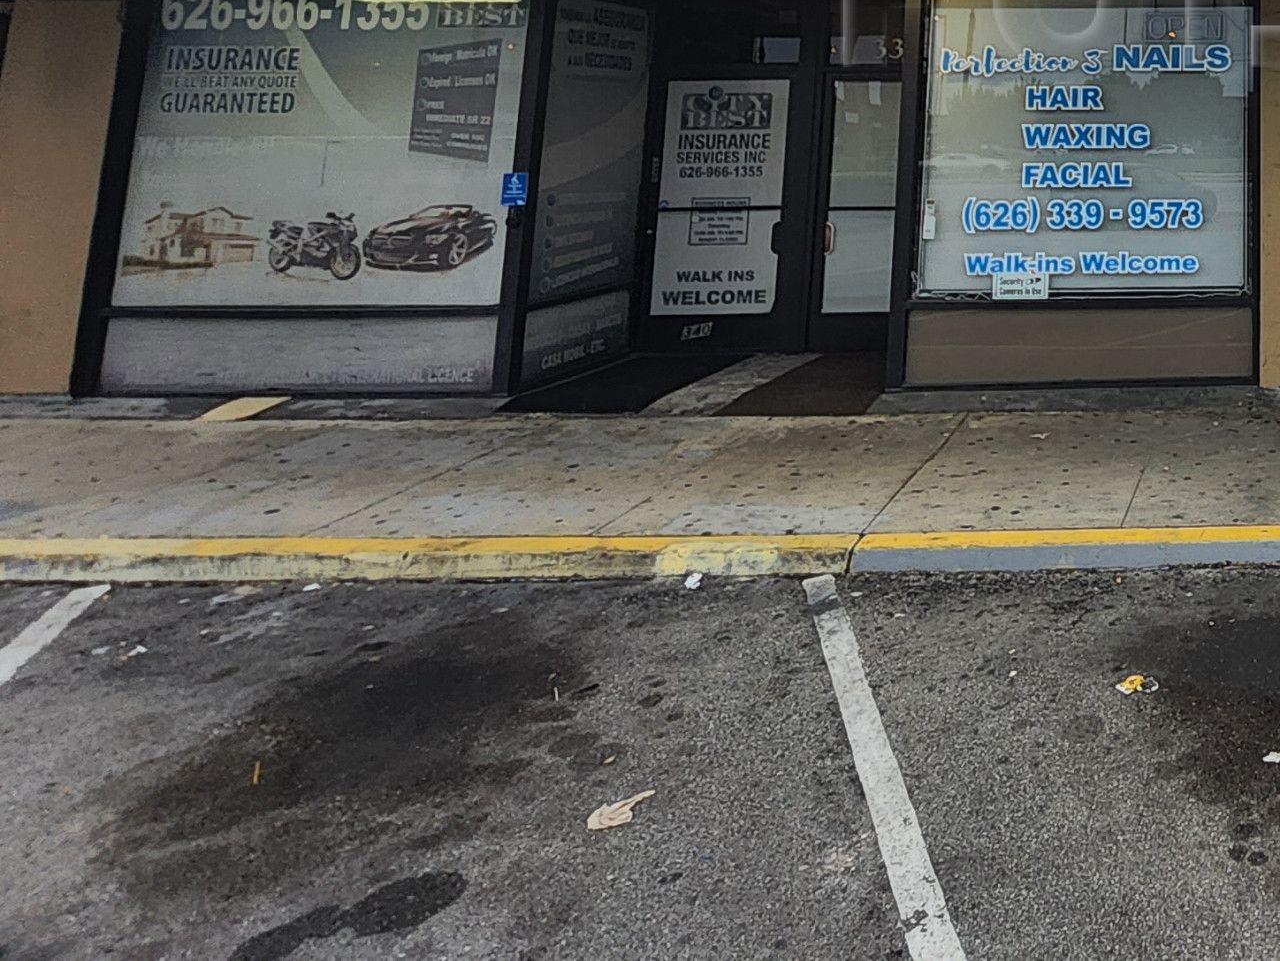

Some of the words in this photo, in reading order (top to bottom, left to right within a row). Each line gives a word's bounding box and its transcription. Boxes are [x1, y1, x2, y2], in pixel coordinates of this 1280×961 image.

[166, 48, 300, 71] INSURANCE
[940, 46, 1080, 78] Perfection
[1081, 50, 1103, 74] 3
[1113, 44, 1232, 72] NAILS
[231, 75, 255, 88] ANY
[257, 75, 297, 89] QUOTE
[160, 92, 295, 114] GUARANTEED
[1025, 86, 1105, 111] HAIR
[678, 133, 772, 150] INSURANCE
[1021, 124, 1151, 149] WAXING
[676, 151, 740, 164] SERVICES
[744, 151, 767, 164] INC
[679, 165, 763, 179] 626-966-1355
[1021, 163, 1133, 188] FACIAL
[962, 197, 1040, 233] (626)
[1047, 200, 1104, 230] 339
[1128, 199, 1203, 230] 9573
[964, 252, 1075, 275] Walk-ins
[1079, 252, 1200, 275] Welcome
[677, 271, 724, 283] WALK
[727, 270, 755, 282] INS
[662, 290, 767, 306] WELCOME
